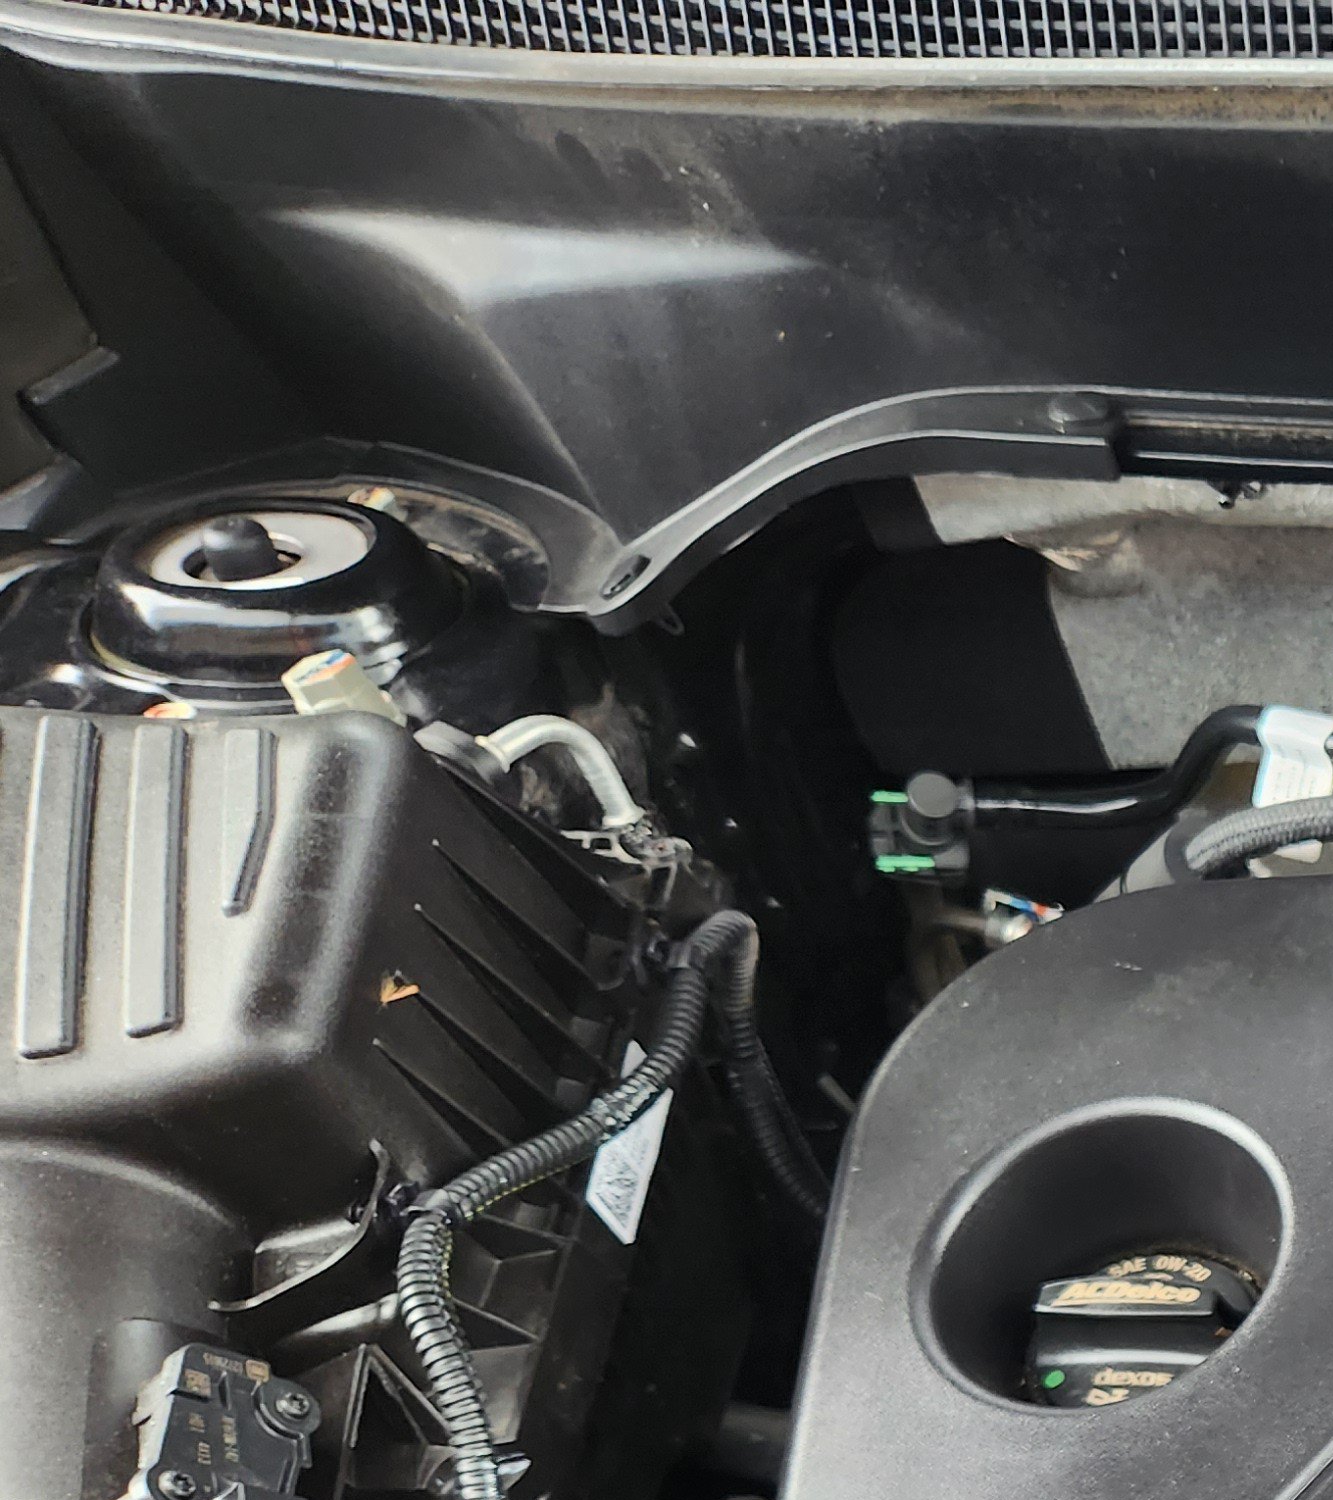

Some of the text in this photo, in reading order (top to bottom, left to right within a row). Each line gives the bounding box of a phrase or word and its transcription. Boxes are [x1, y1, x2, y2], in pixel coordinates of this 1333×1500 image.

[1107, 1254, 1212, 1283] SAE 0W-20
[1056, 1281, 1201, 1304] ACDelco
